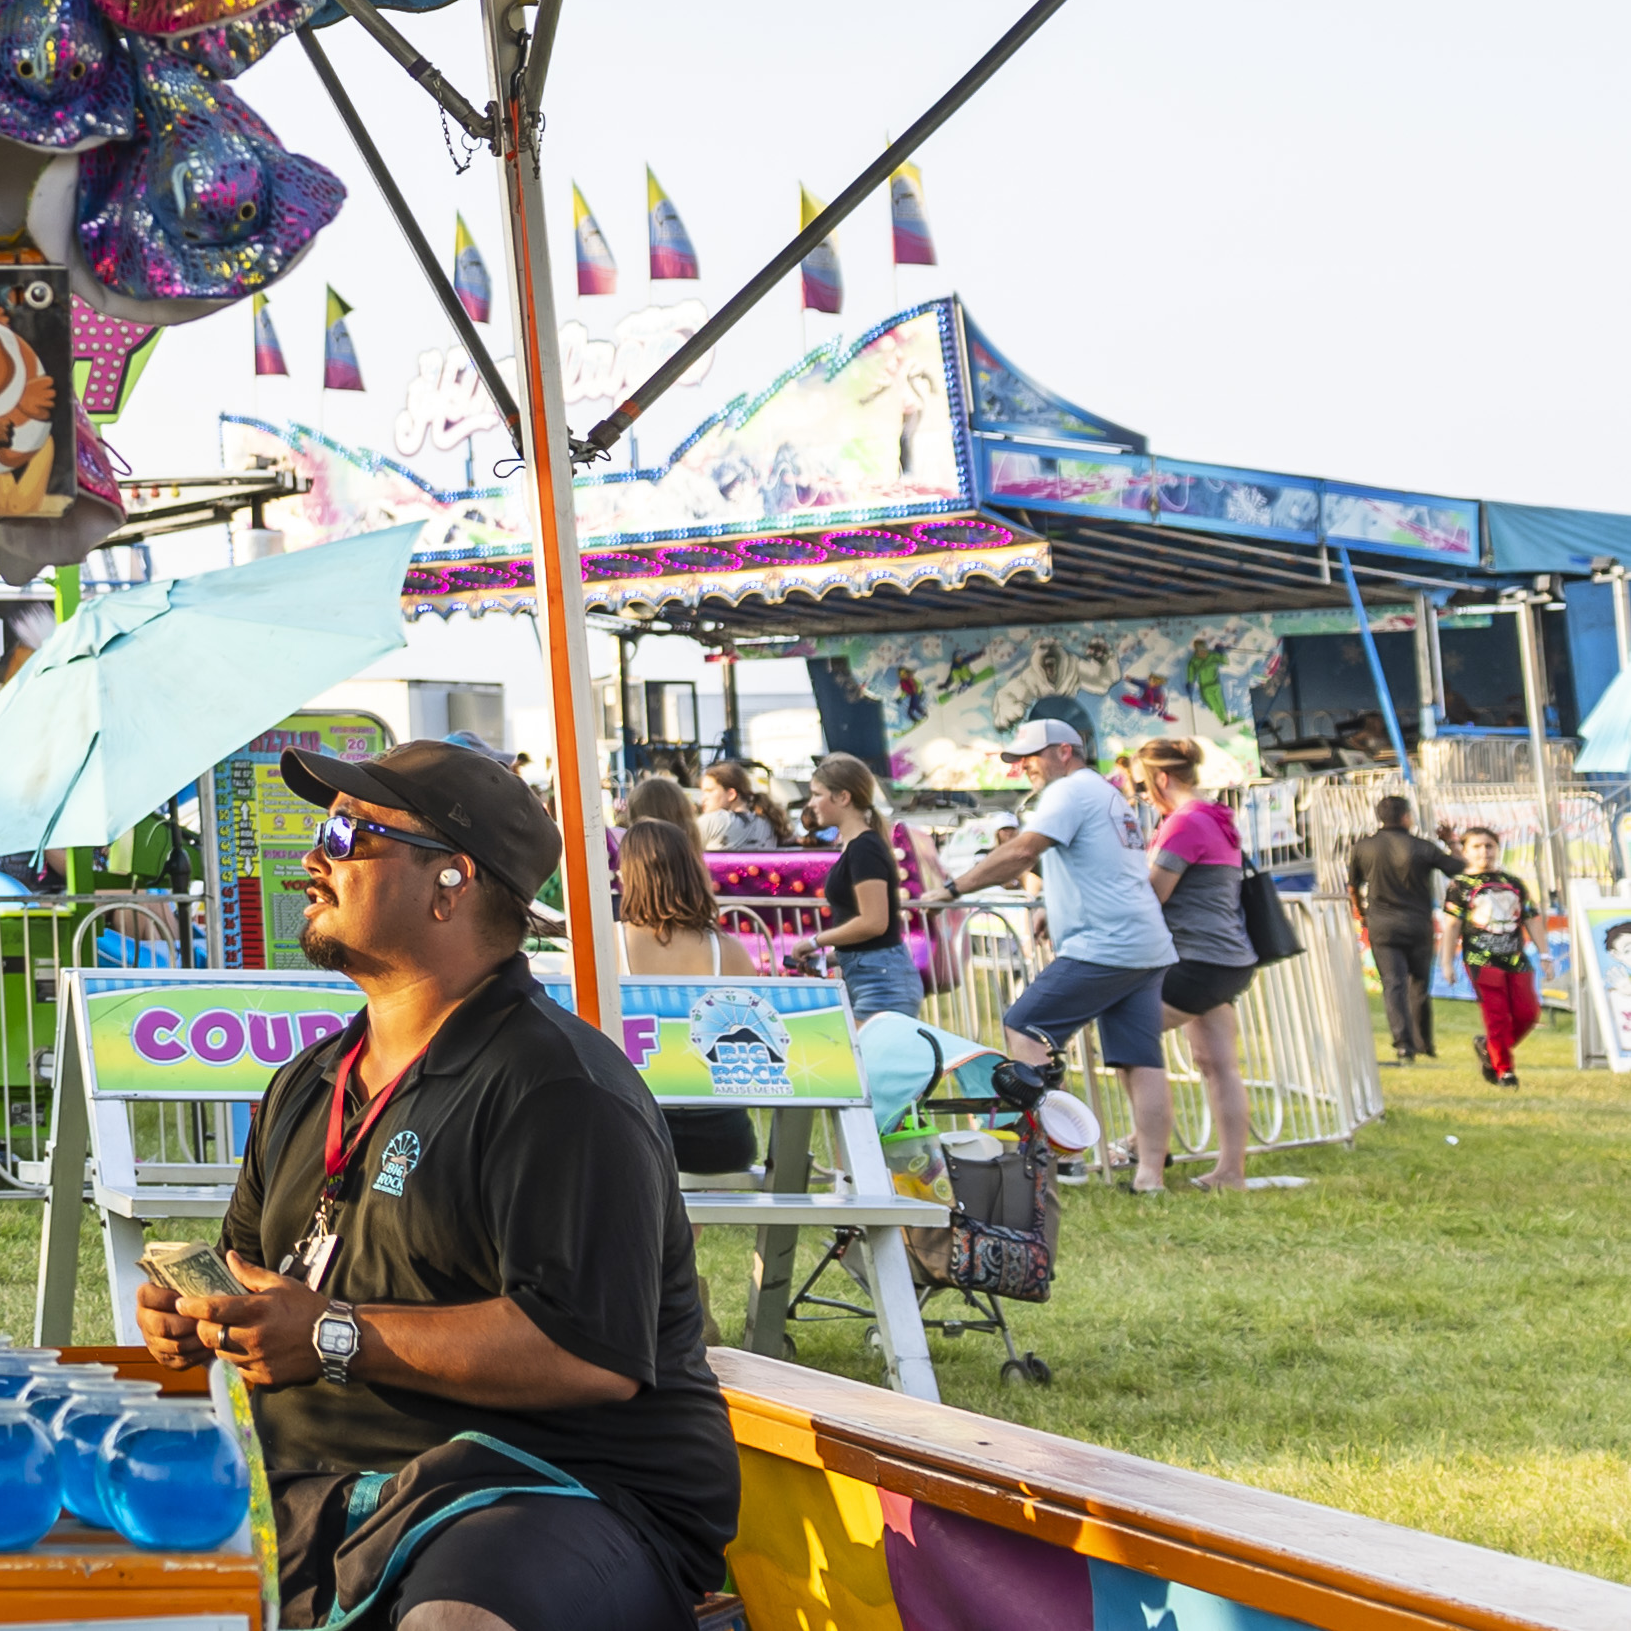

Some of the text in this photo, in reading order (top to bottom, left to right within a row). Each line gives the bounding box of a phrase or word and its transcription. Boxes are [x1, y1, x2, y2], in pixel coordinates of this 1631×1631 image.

[347, 737, 367, 751] 20
[717, 1044, 769, 1064] BIG
[711, 1065, 791, 1085] ROCK
[714, 1086, 793, 1095] AMUSEMENTS
[385, 1161, 405, 1177] BIG
[376, 1171, 405, 1190] ROCK
